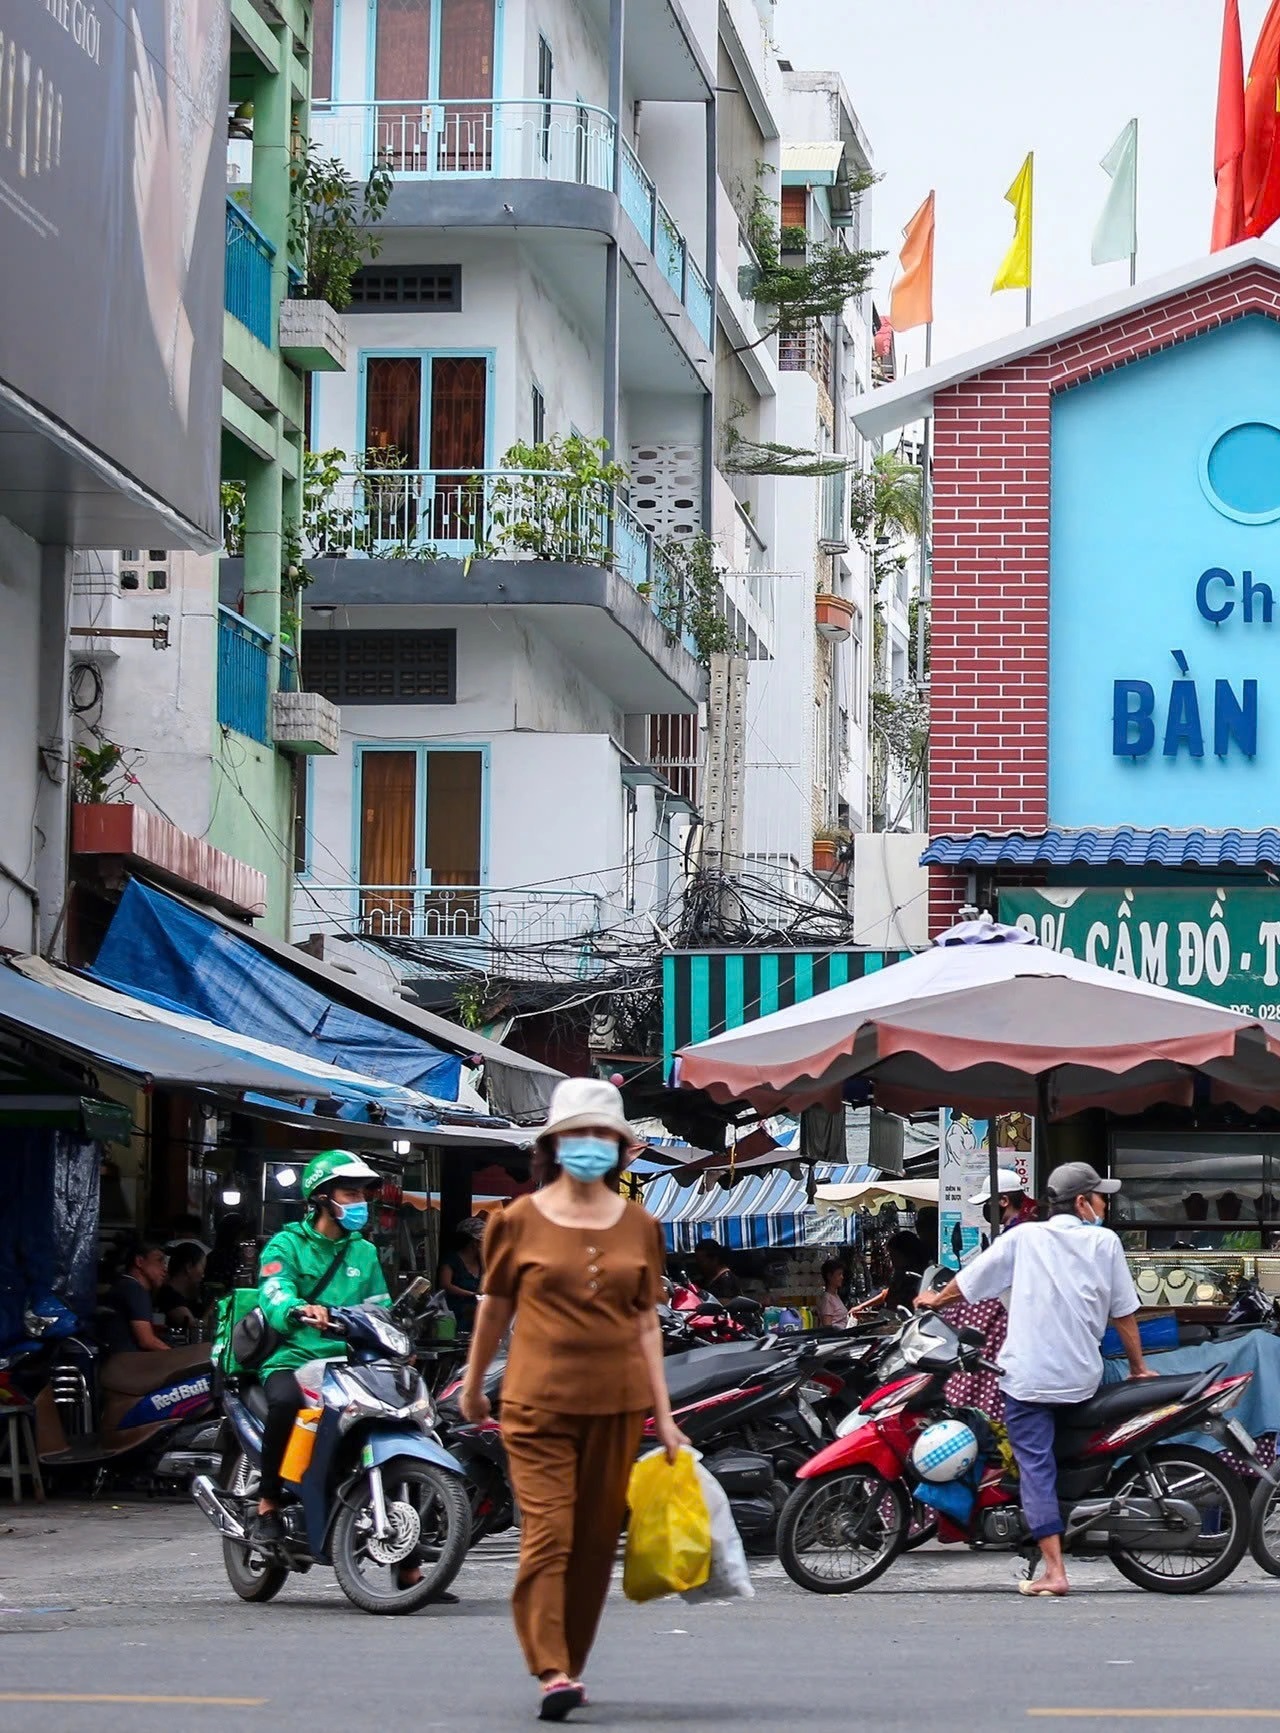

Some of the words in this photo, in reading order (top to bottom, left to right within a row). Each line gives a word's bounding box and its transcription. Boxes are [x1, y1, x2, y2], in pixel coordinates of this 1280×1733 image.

[1112, 649, 1259, 757] BÀN
[1178, 888, 1232, 987] ĐỒ
[304, 1169, 324, 1189] Grab
